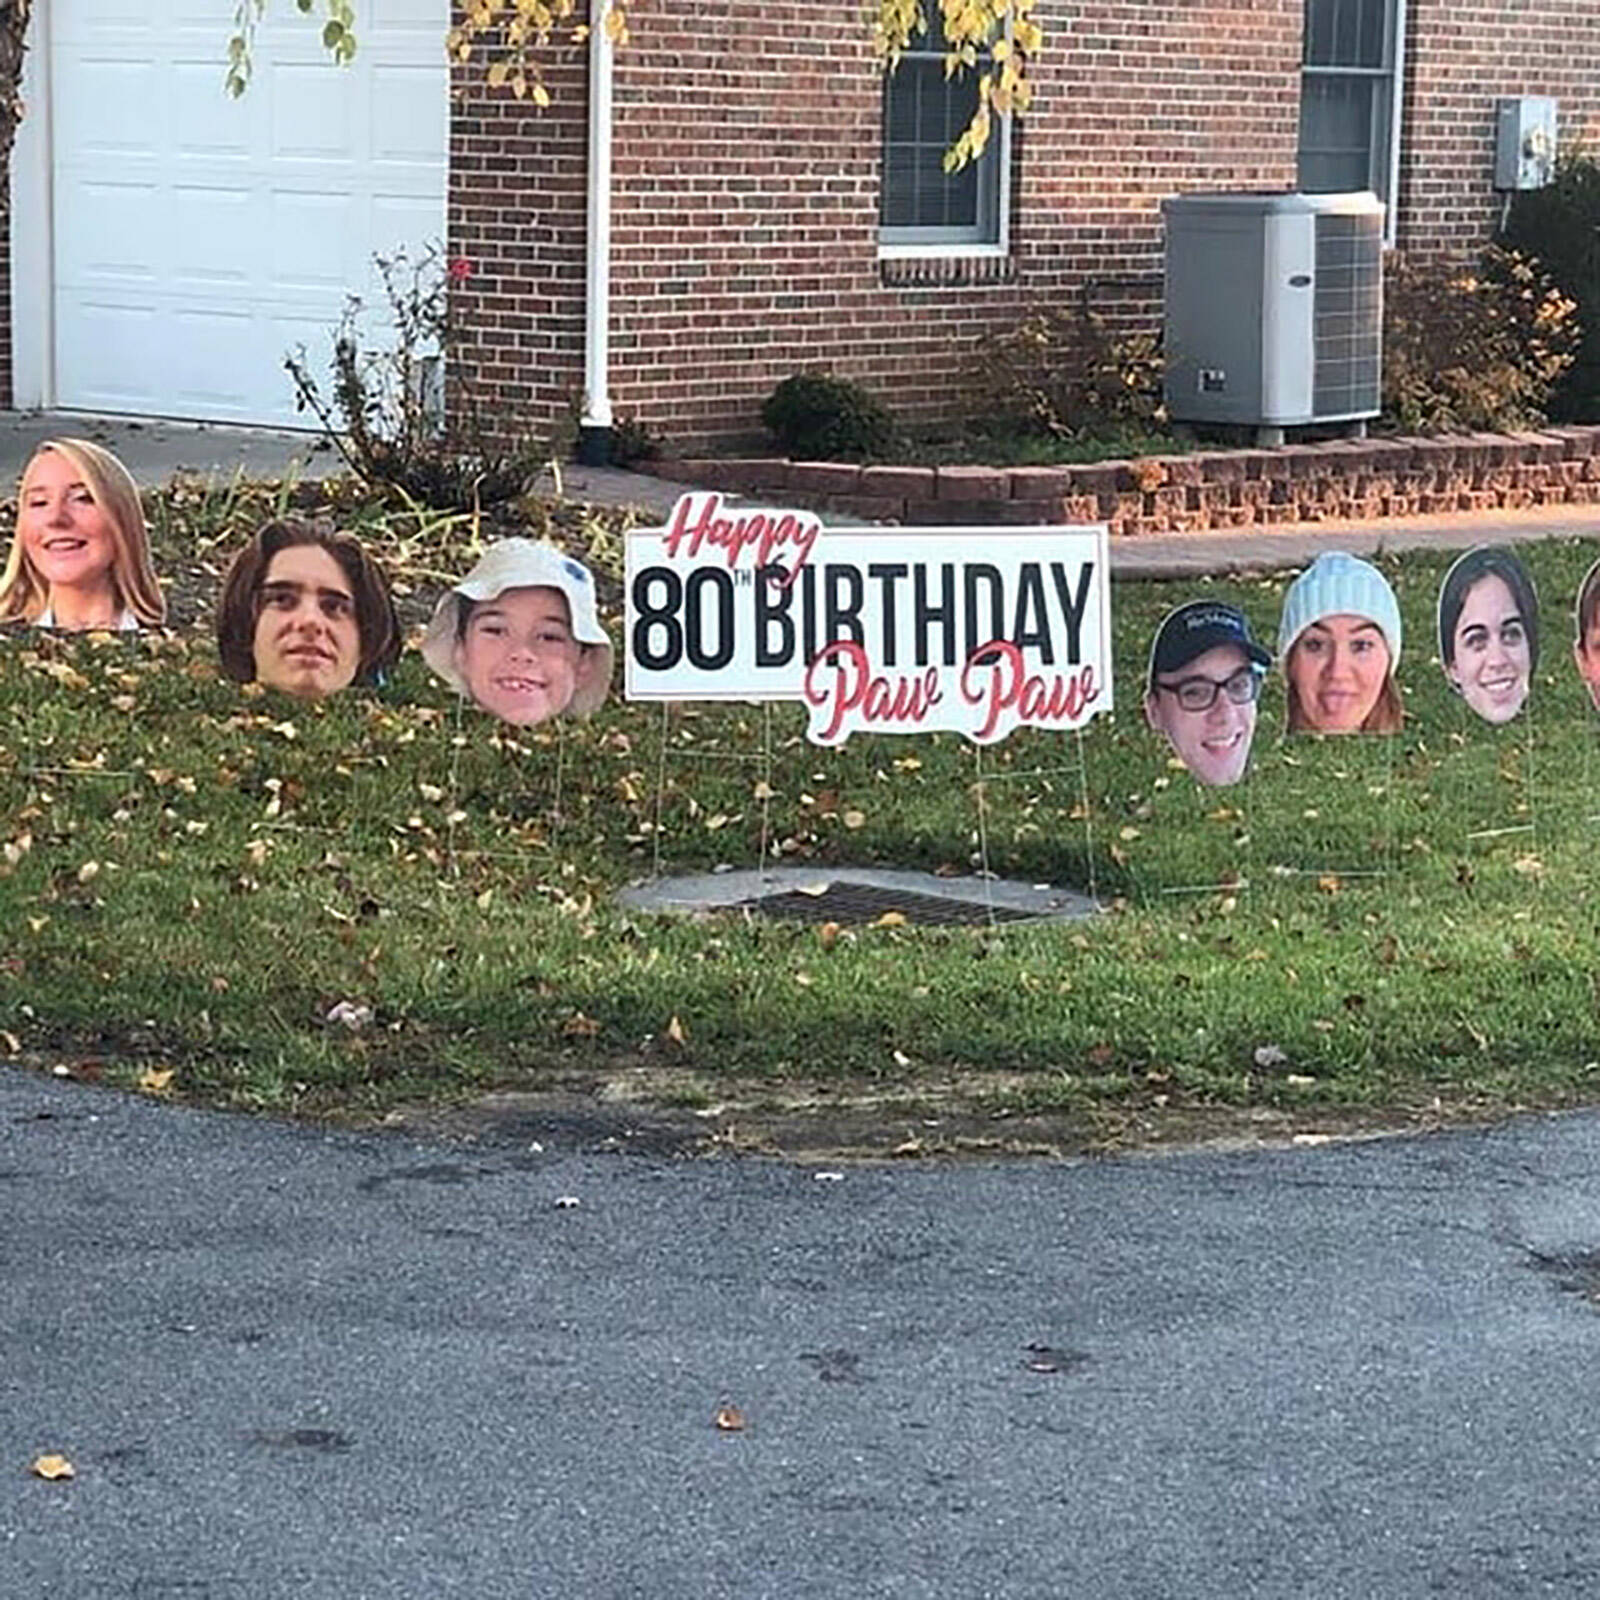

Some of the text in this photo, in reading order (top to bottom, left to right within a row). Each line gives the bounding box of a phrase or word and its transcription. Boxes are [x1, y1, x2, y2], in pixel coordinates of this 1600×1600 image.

[662, 494, 820, 590] Happy
[754, 561, 1095, 668] BIRTHDAY
[804, 639, 1100, 740] Paw Paw
